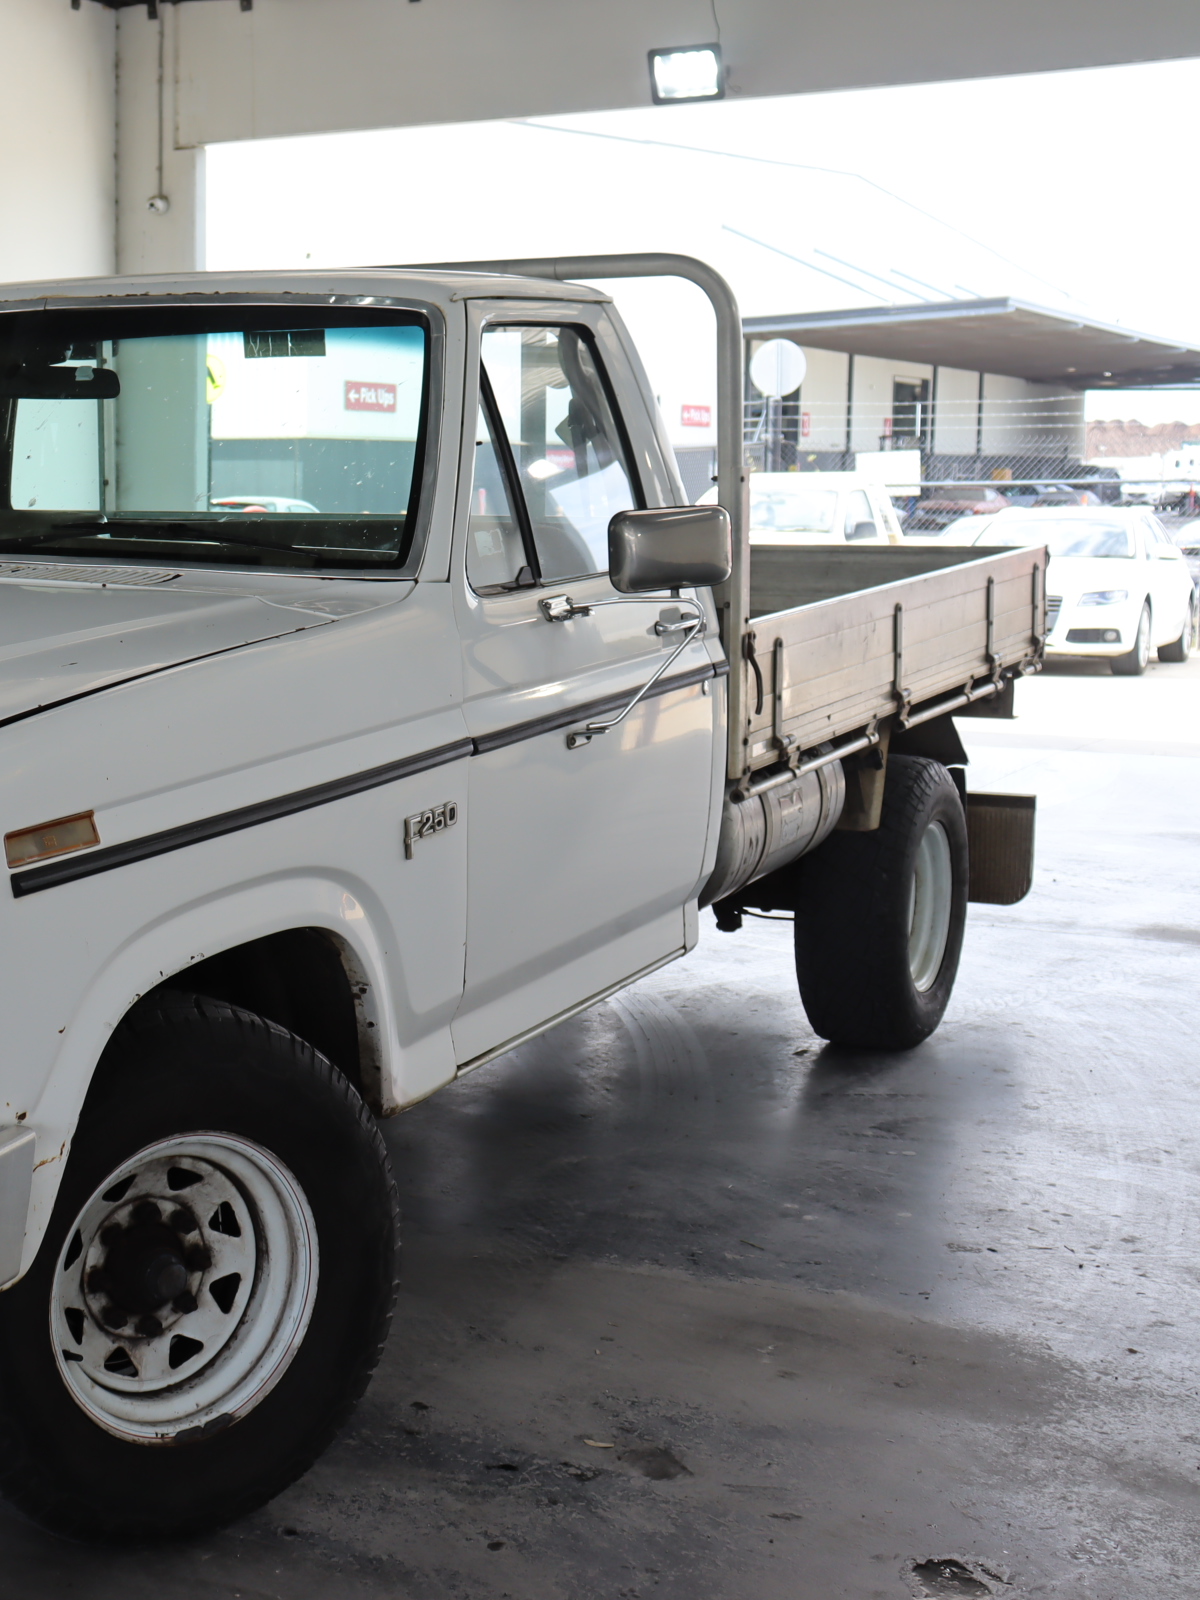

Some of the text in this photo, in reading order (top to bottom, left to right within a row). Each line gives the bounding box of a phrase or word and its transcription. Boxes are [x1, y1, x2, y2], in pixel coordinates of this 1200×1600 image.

[360, 387, 395, 408] Pick Ups
[403, 800, 458, 860] F250
